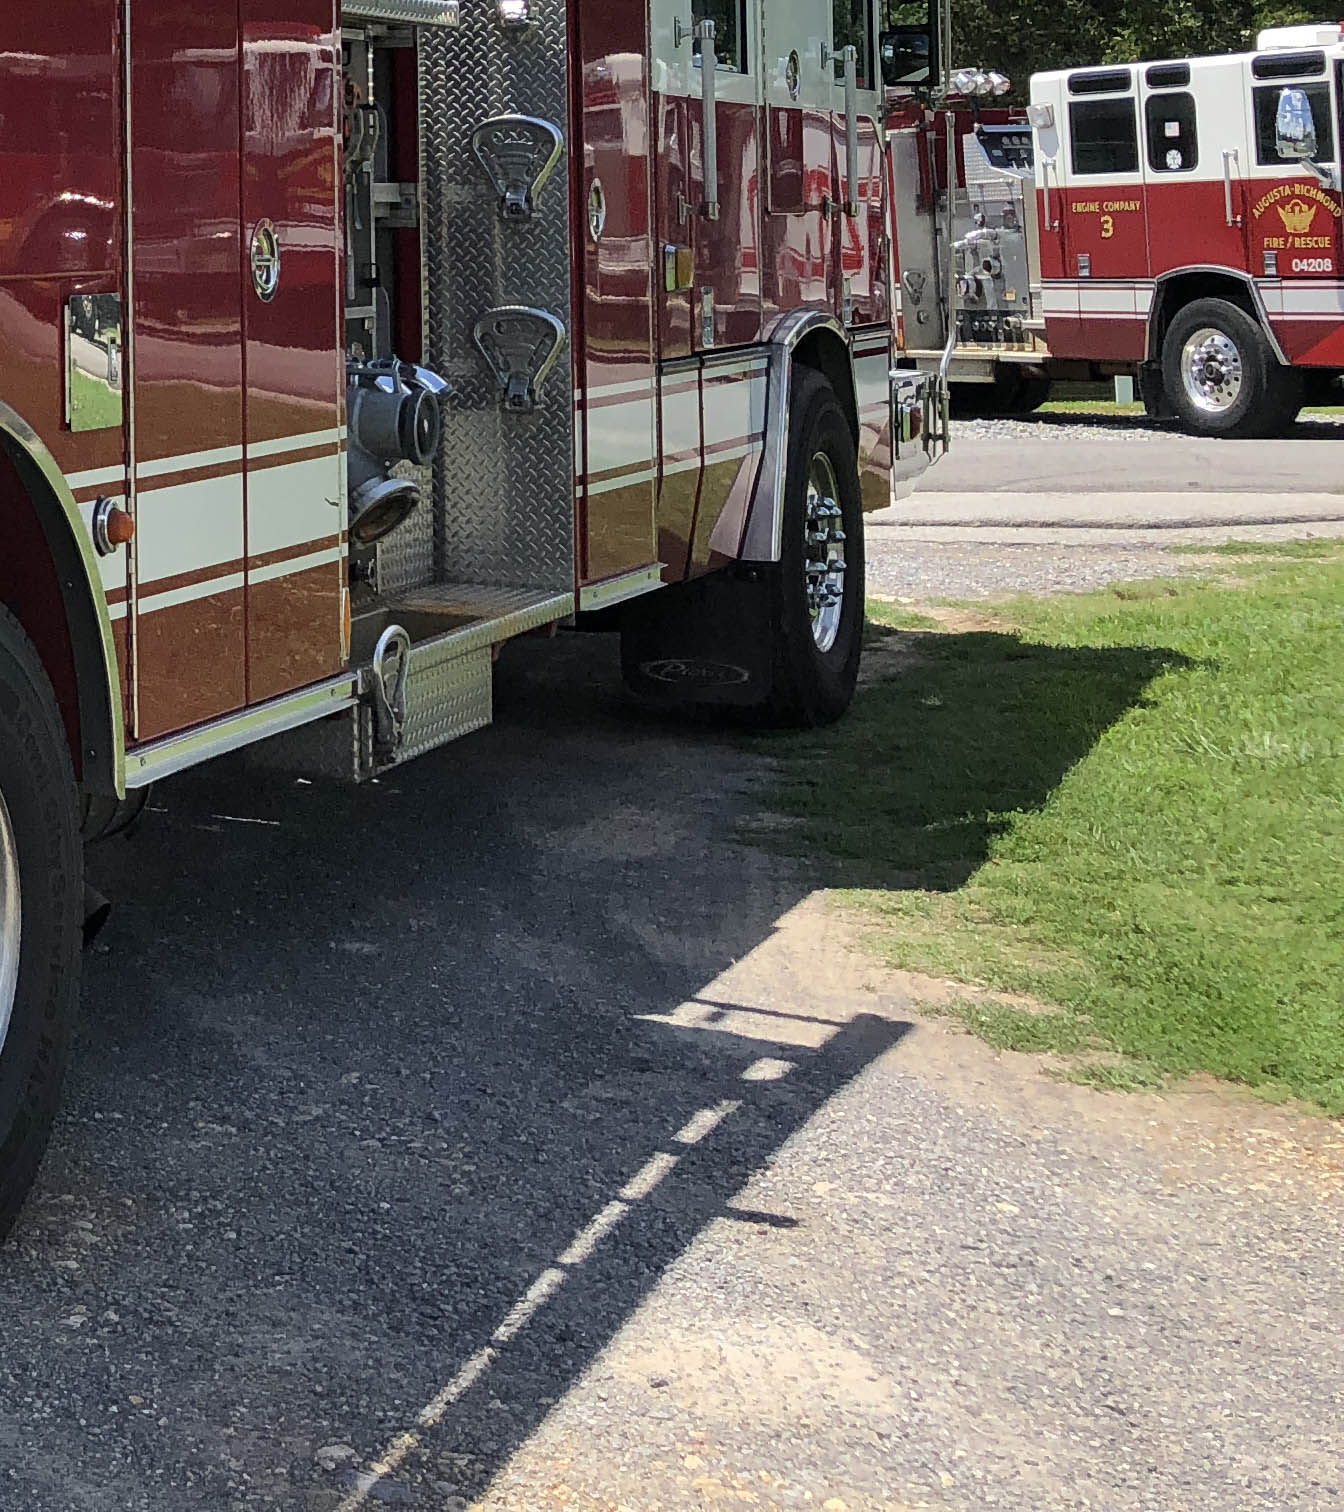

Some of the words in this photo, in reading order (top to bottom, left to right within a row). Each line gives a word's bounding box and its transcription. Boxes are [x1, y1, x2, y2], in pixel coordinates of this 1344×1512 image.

[1072, 201, 1100, 213] ENGINE
[1102, 200, 1141, 212] COMPANY
[1252, 183, 1342, 220] AUGUSTA-RICHMOND
[1100, 214, 1114, 238] 3
[1291, 258, 1333, 272] 04208
